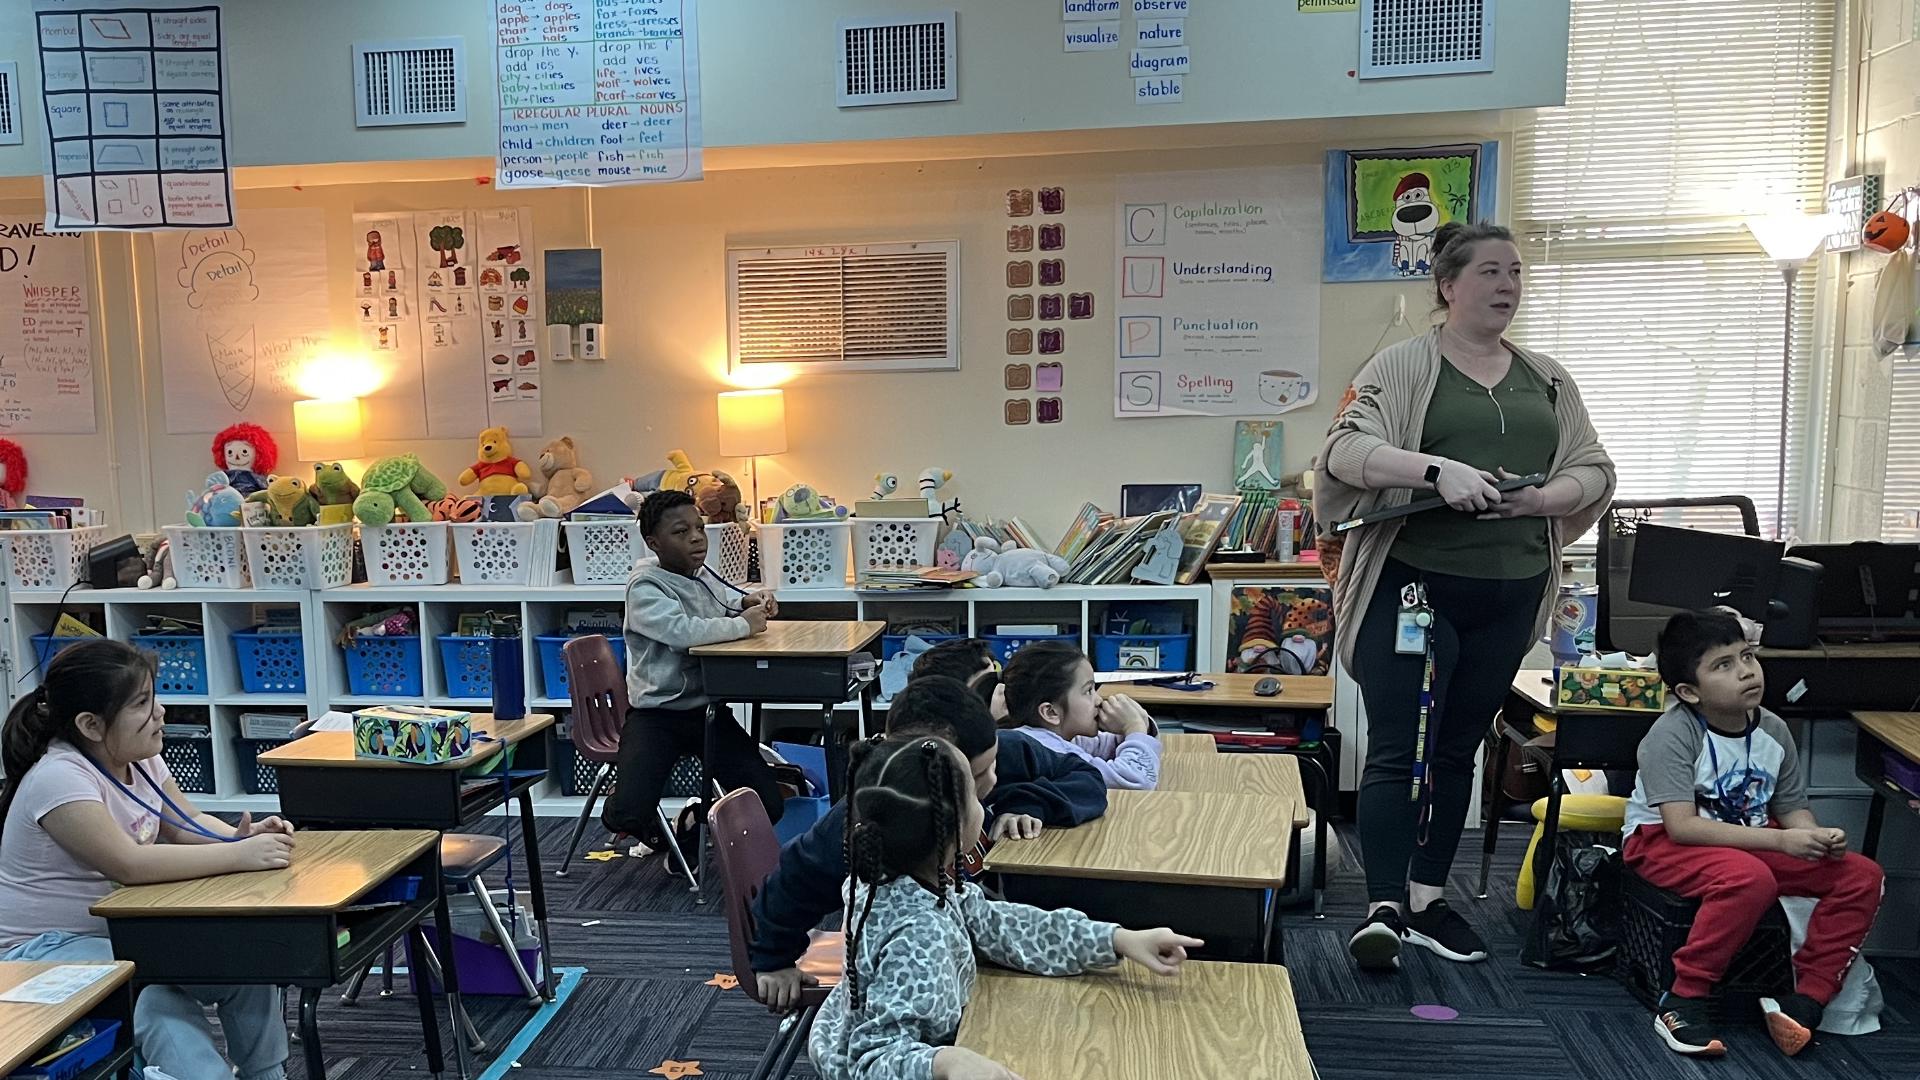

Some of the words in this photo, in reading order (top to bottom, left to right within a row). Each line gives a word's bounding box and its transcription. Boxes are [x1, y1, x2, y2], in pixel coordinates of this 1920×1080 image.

[500, 3, 521, 15] dog
[544, 1, 573, 12] dogs
[1064, 0, 1120, 14] landform
[1134, 0, 1188, 11] observe
[499, 14, 530, 28] apple
[544, 12, 581, 26] apples
[596, 8, 616, 20] fox
[42, 26, 77, 37] rhombus
[499, 27, 527, 36] chair
[542, 25, 580, 34] chairs
[594, 20, 628, 30] dress
[1139, 24, 1182, 40] nature
[501, 36, 521, 44] hat
[542, 34, 568, 42] hats
[596, 28, 634, 39] branch
[1066, 26, 1119, 45] visualize
[599, 41, 631, 53] drop
[638, 40, 657, 50] the
[505, 46, 534, 62] drop
[541, 46, 560, 58] the
[602, 56, 626, 66] add
[636, 56, 658, 65] ves
[505, 61, 527, 72] add
[536, 62, 554, 71] ies
[1131, 53, 1189, 72] diagram
[500, 72, 520, 83] city
[596, 69, 616, 78] life
[634, 66, 661, 76] lives
[501, 82, 530, 94] baby
[540, 80, 576, 92] babies
[596, 79, 621, 89] wolf
[633, 77, 671, 87] wolves
[1138, 80, 1181, 98] stable
[503, 94, 519, 106] fly
[530, 94, 555, 104] flies
[635, 91, 676, 100] scarves
[50, 105, 82, 118] square
[513, 108, 581, 120] IRREGULAR
[586, 106, 631, 118] PLURAL
[640, 104, 684, 115] NOUNS
[502, 123, 528, 132] man
[542, 122, 569, 131] men
[602, 120, 628, 130] deer
[643, 117, 673, 127] deer
[502, 138, 533, 150] child
[544, 136, 595, 148] children
[600, 134, 623, 145] foot
[639, 131, 664, 142] feet
[504, 155, 542, 167] person
[554, 151, 590, 165] people
[598, 151, 624, 162] fish
[639, 149, 664, 160] fish
[598, 166, 632, 176] mouse
[642, 165, 668, 174] mice
[1442, 159, 1460, 175] 123
[505, 168, 545, 184] goose
[556, 166, 592, 180] geese
[1173, 200, 1263, 221] Capitalization
[1130, 208, 1155, 243] C
[188, 231, 230, 256] Detail
[206, 260, 244, 282] Detail
[1046, 265, 1054, 279] 9
[1173, 262, 1273, 282] Understanding
[1130, 263, 1155, 295] U
[22, 282, 80, 298] WHISPER
[1046, 300, 1055, 315] 8
[1074, 300, 1085, 314] 7
[22, 317, 36, 326] ED
[1173, 317, 1259, 332] Punctuation
[75, 328, 84, 338] T
[1128, 321, 1152, 354] P
[1043, 335, 1055, 348] 12
[1126, 374, 1154, 407] S
[1177, 374, 1234, 394] Spelling
[473, 627, 490, 637] WIL
